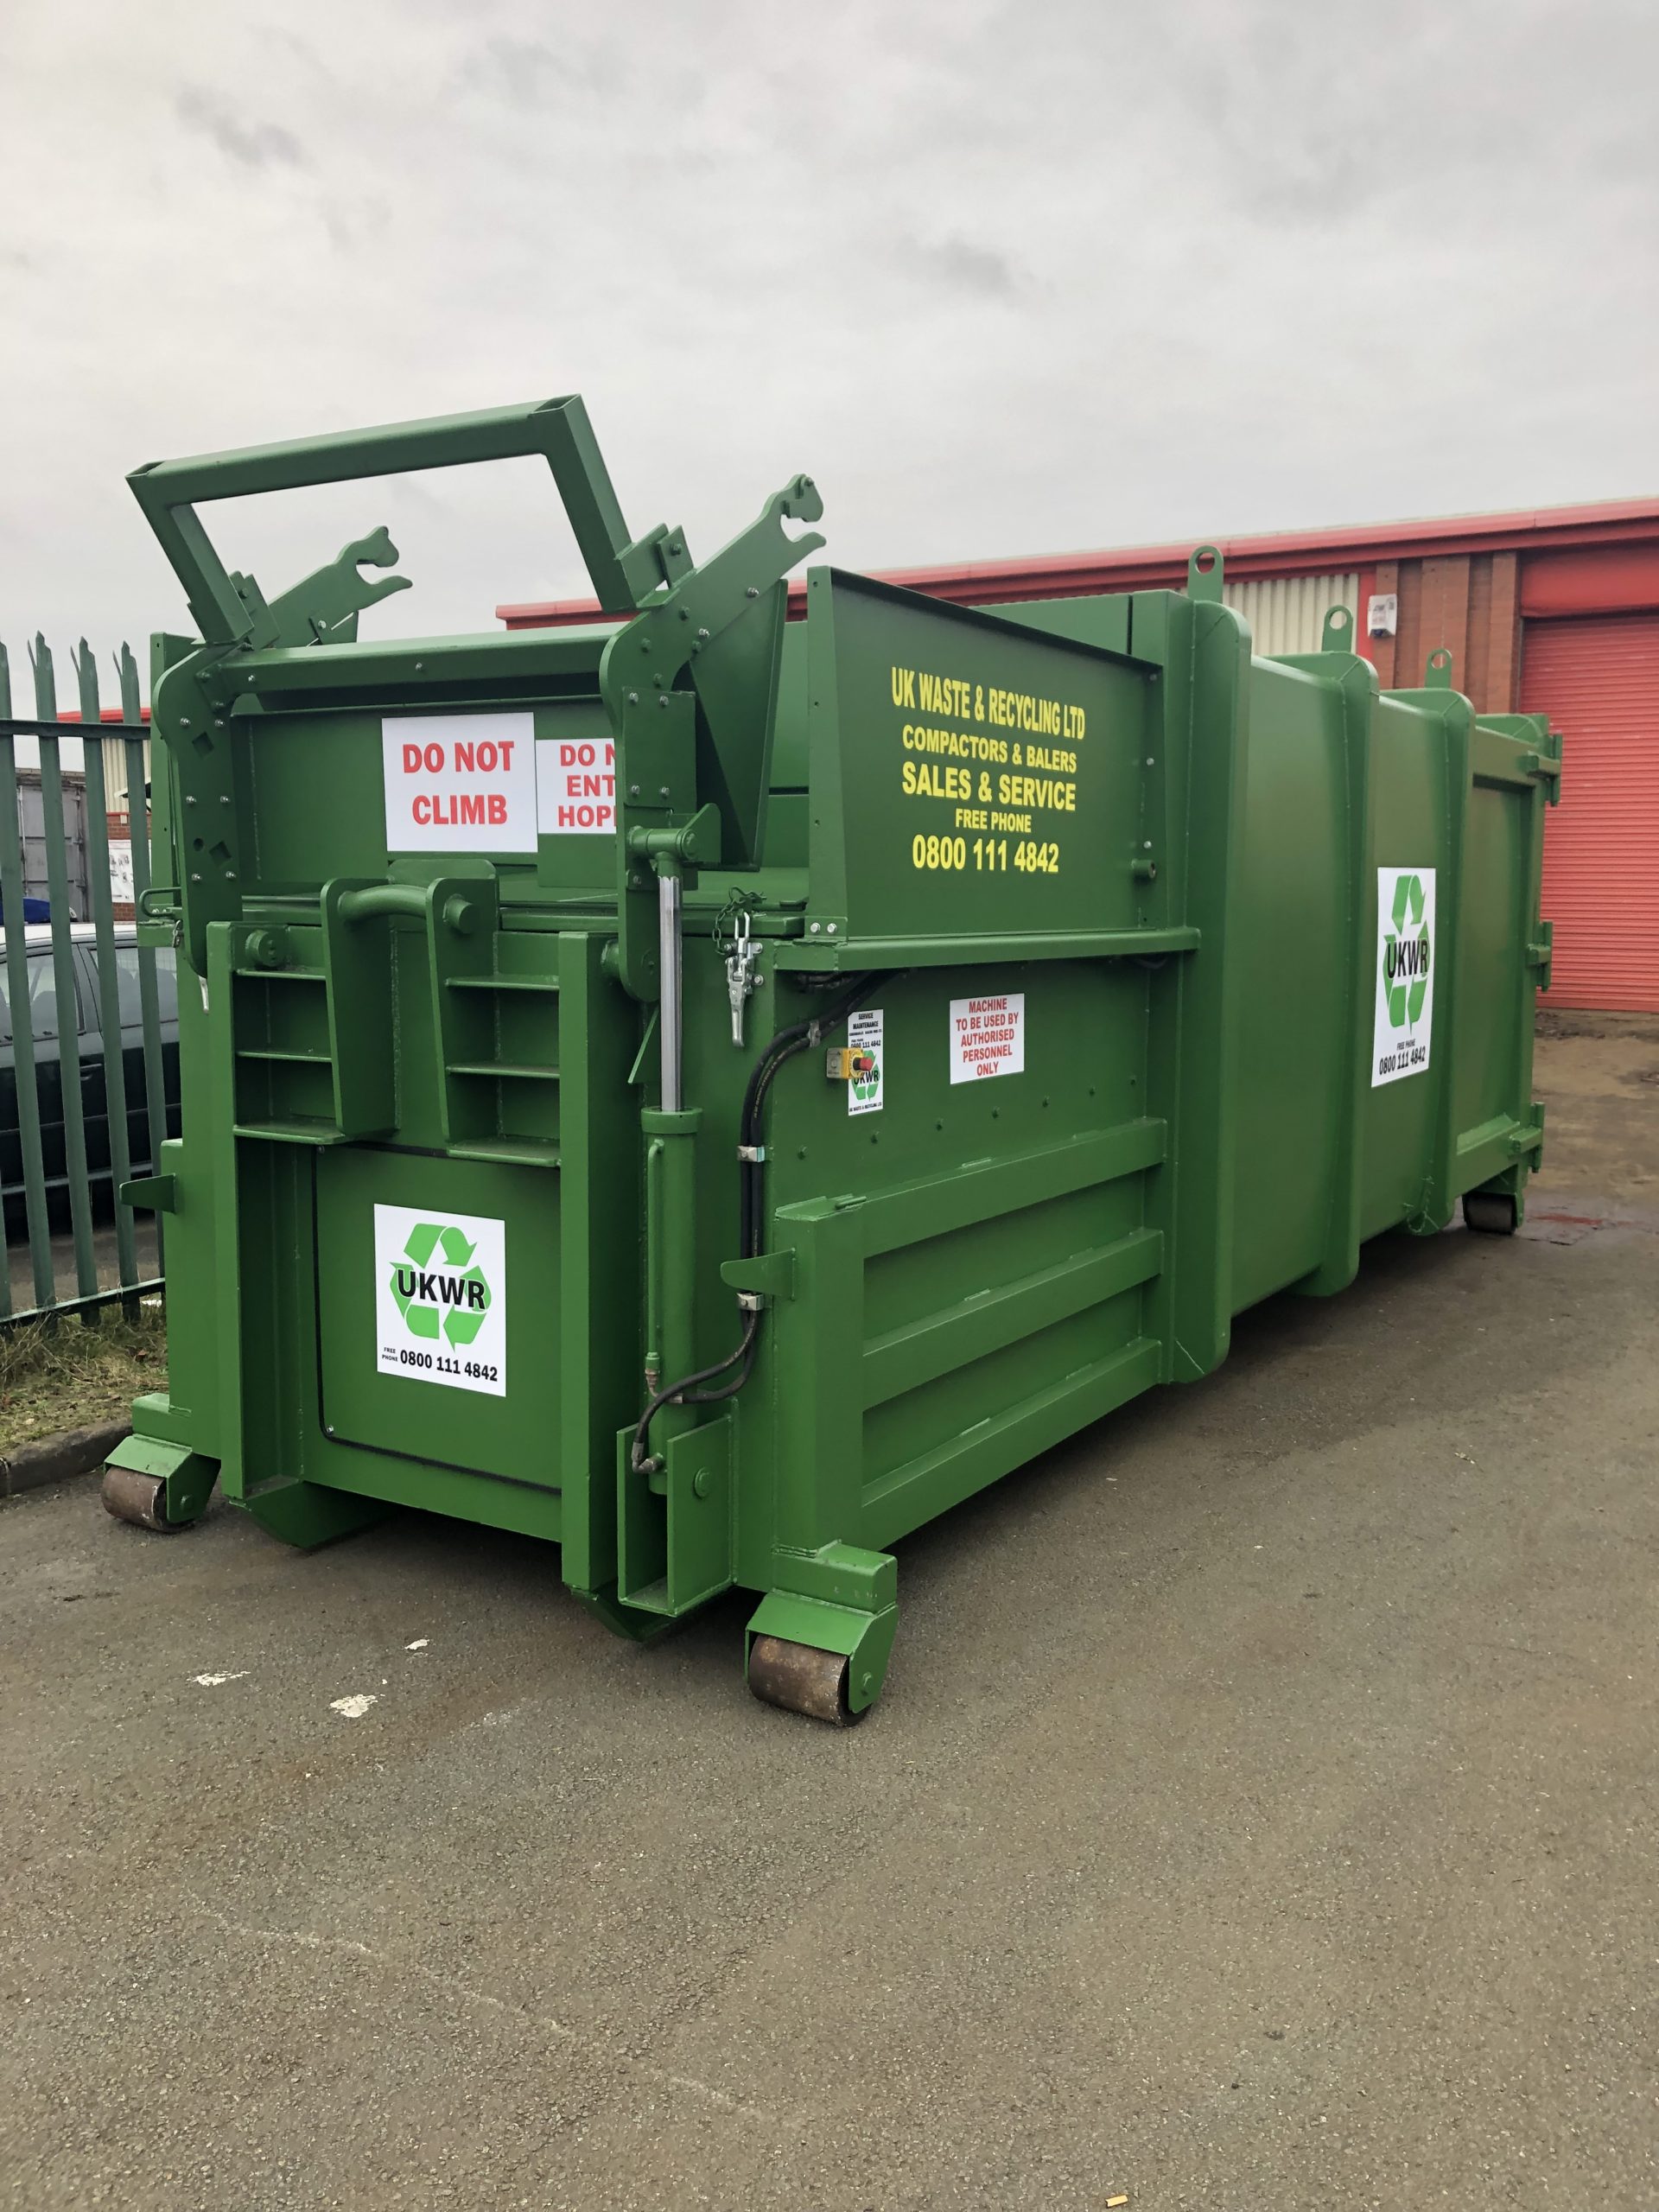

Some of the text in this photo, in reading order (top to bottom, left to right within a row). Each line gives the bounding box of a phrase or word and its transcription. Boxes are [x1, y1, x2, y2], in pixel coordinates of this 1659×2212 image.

[891, 666, 1085, 740] UK WASTE & RECYCLING LTD
[403, 741, 515, 773] DO NOT
[560, 744, 595, 766] DO
[902, 724, 1077, 773] COMPACTORS & BALERS
[902, 761, 1077, 811] SALES & SERVICE
[412, 794, 508, 825] CLIMB
[558, 804, 618, 827] HOP
[956, 808, 1032, 833] FREE PHONE
[912, 834, 1059, 873] 0800 111 4842
[1387, 939, 1427, 979] UKWR
[858, 1012, 874, 1020] SERVICE
[969, 998, 1007, 1014] MACHINE
[853, 1020, 879, 1030] MAINTENANCE
[956, 1012, 1019, 1032] TO BE USED BY
[961, 1028, 1014, 1047] AUTHORISED
[963, 1044, 1013, 1063] PERSONNEL
[1379, 1045, 1426, 1076] 0800 111 4842
[976, 1061, 999, 1077] ONLY
[397, 1268, 486, 1310] UKWR
[381, 1354, 398, 1363] PHONE
[384, 1346, 397, 1355] FREE
[400, 1349, 499, 1382] 0800 111 4842
